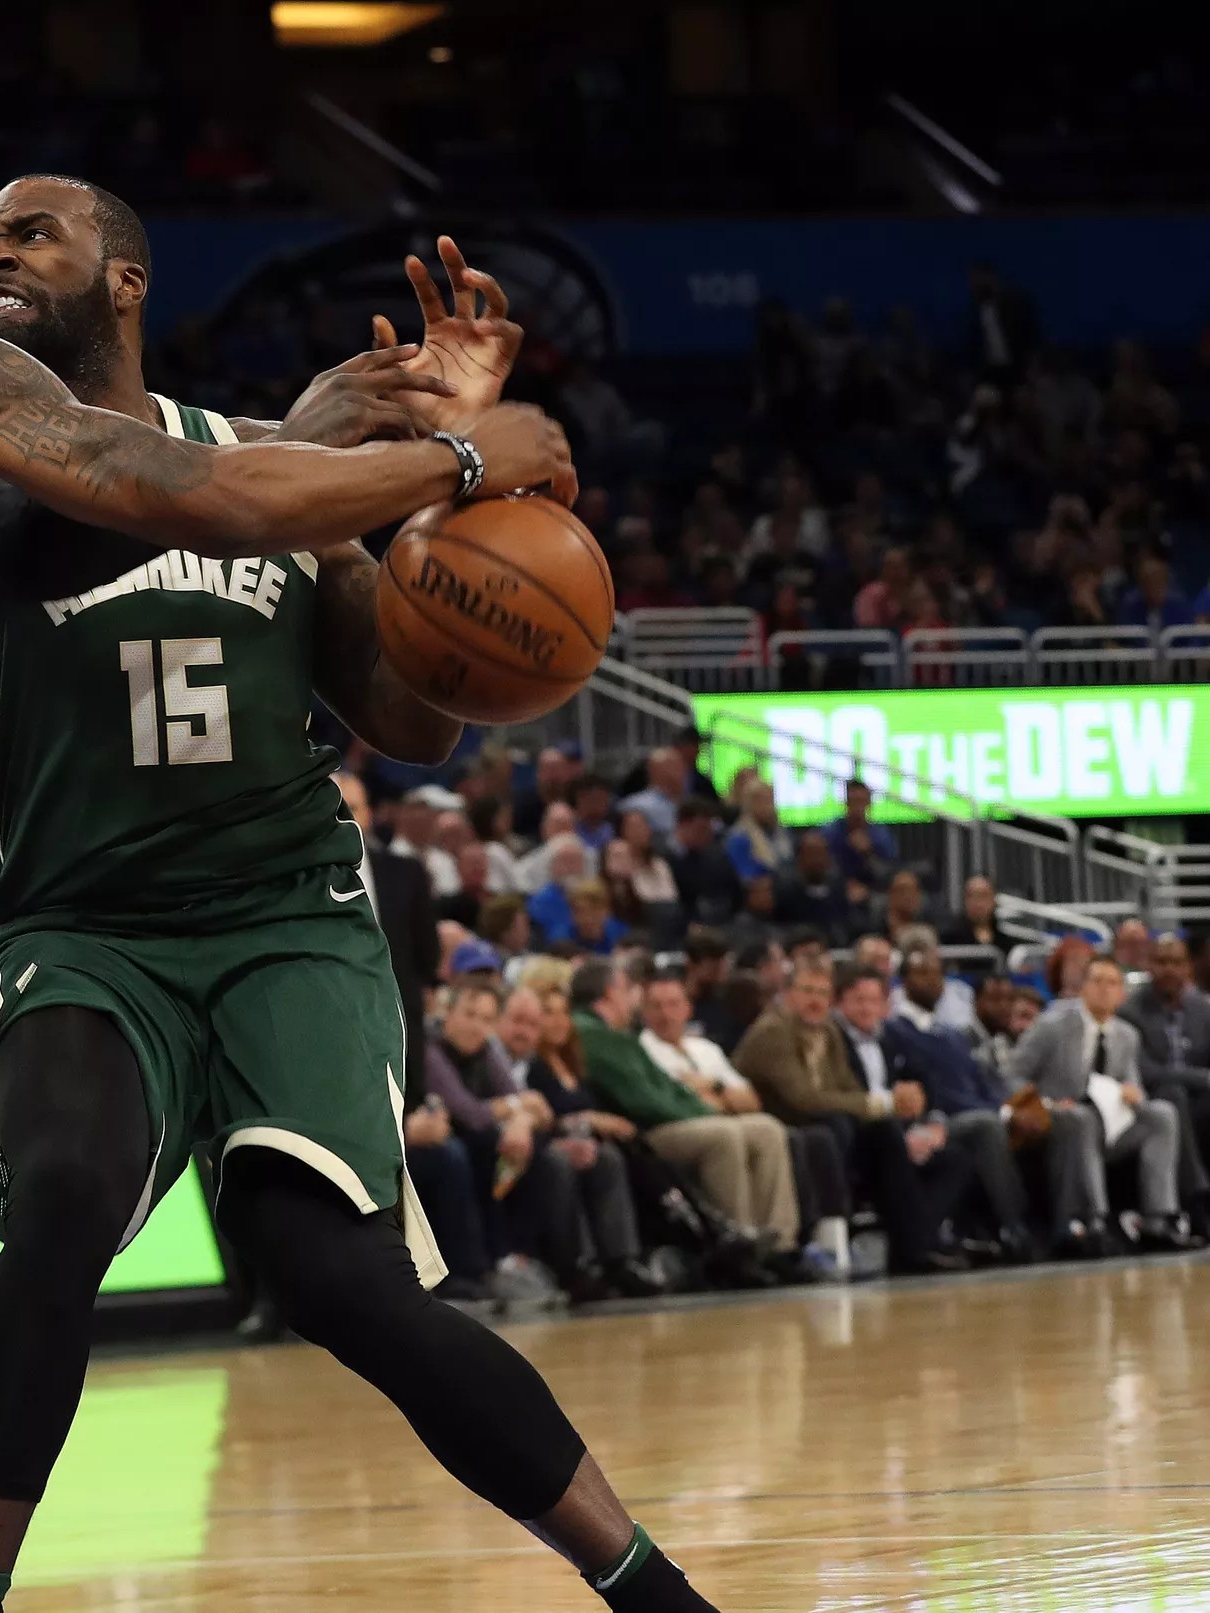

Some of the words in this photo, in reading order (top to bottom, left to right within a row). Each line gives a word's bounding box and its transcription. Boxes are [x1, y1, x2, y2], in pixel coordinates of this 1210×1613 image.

[40, 548, 288, 627] MWAUKEE
[409, 555, 564, 673] SPALDING
[118, 636, 234, 767] 15
[764, 705, 887, 809] DO
[891, 732, 1004, 803] THE
[1001, 700, 1194, 799] DEW
